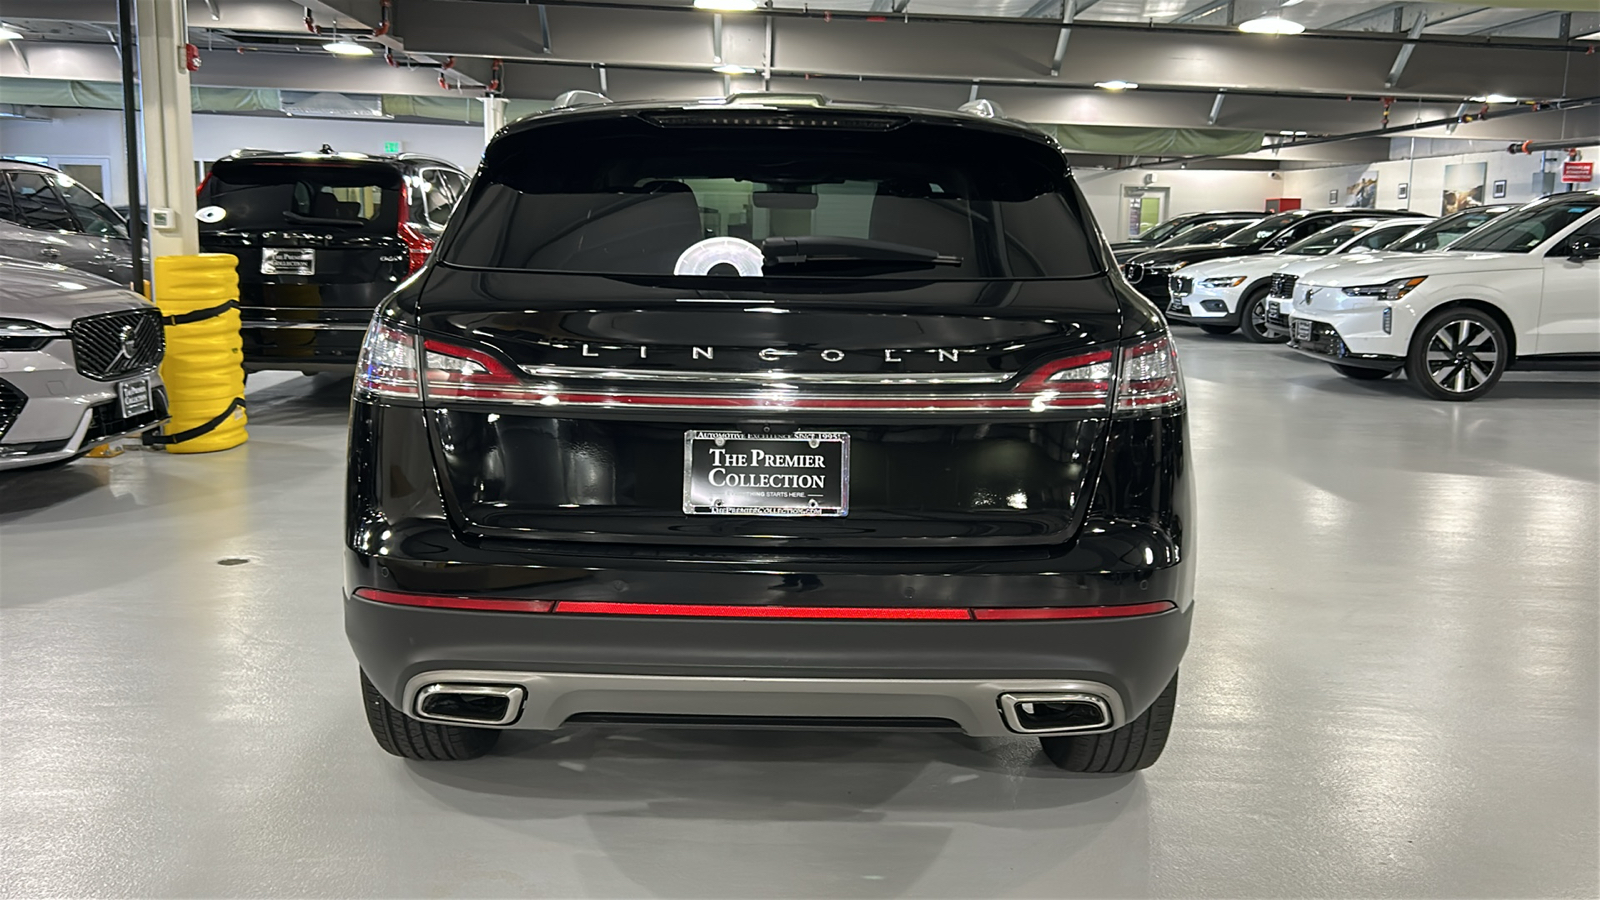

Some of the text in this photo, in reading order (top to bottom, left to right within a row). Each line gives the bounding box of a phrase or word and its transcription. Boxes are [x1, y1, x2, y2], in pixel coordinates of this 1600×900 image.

[582, 343, 960, 363] LINCOLN
[697, 431, 745, 439] AUTOMOTIVE
[794, 432, 815, 440] SINCE
[709, 448, 825, 468] THE PREMIER
[708, 467, 825, 488] COLLECTION
